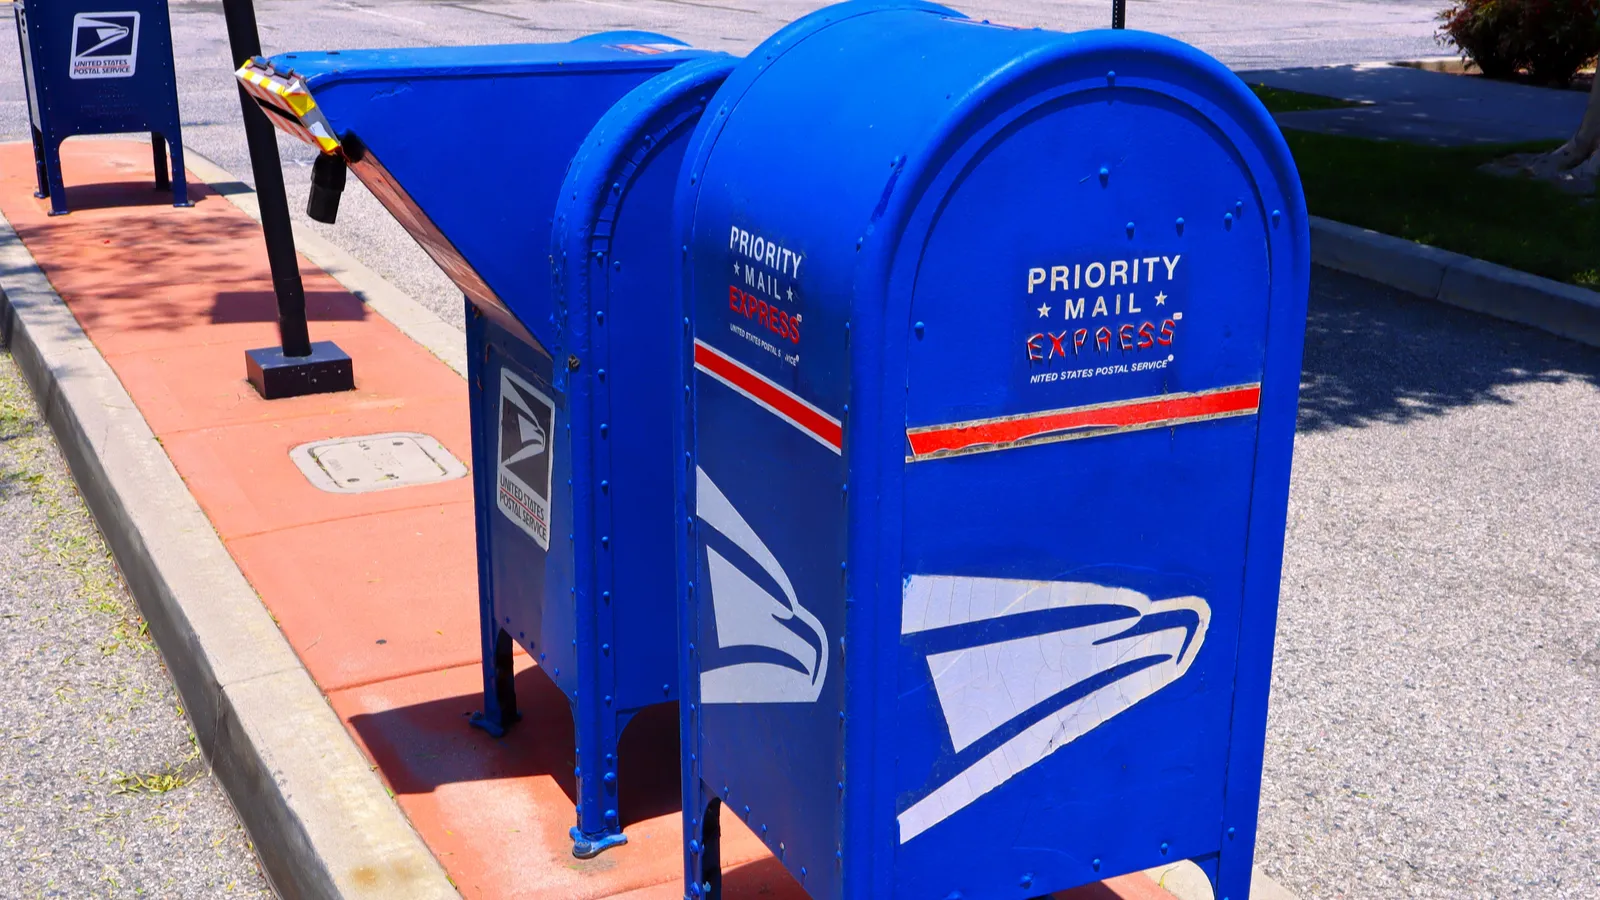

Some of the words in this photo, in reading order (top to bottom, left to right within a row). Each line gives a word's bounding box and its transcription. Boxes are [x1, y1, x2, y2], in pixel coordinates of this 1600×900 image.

[729, 225, 802, 279] PRIORITY
[745, 264, 781, 300] MAIL
[1027, 254, 1181, 294] PRIORITY
[729, 285, 800, 344] EXPRESS
[1064, 292, 1142, 320] MAIL
[729, 323, 746, 338] UNITED
[745, 331, 761, 346] STATES
[761, 340, 777, 356] POSTAL
[1060, 368, 1094, 380] STATES
[1095, 364, 1129, 376] POSTAL
[499, 490, 522, 520] POSTAL
[522, 510, 547, 542] SERVICE
[500, 473, 523, 502] UNITED
[523, 493, 545, 521] STATES
